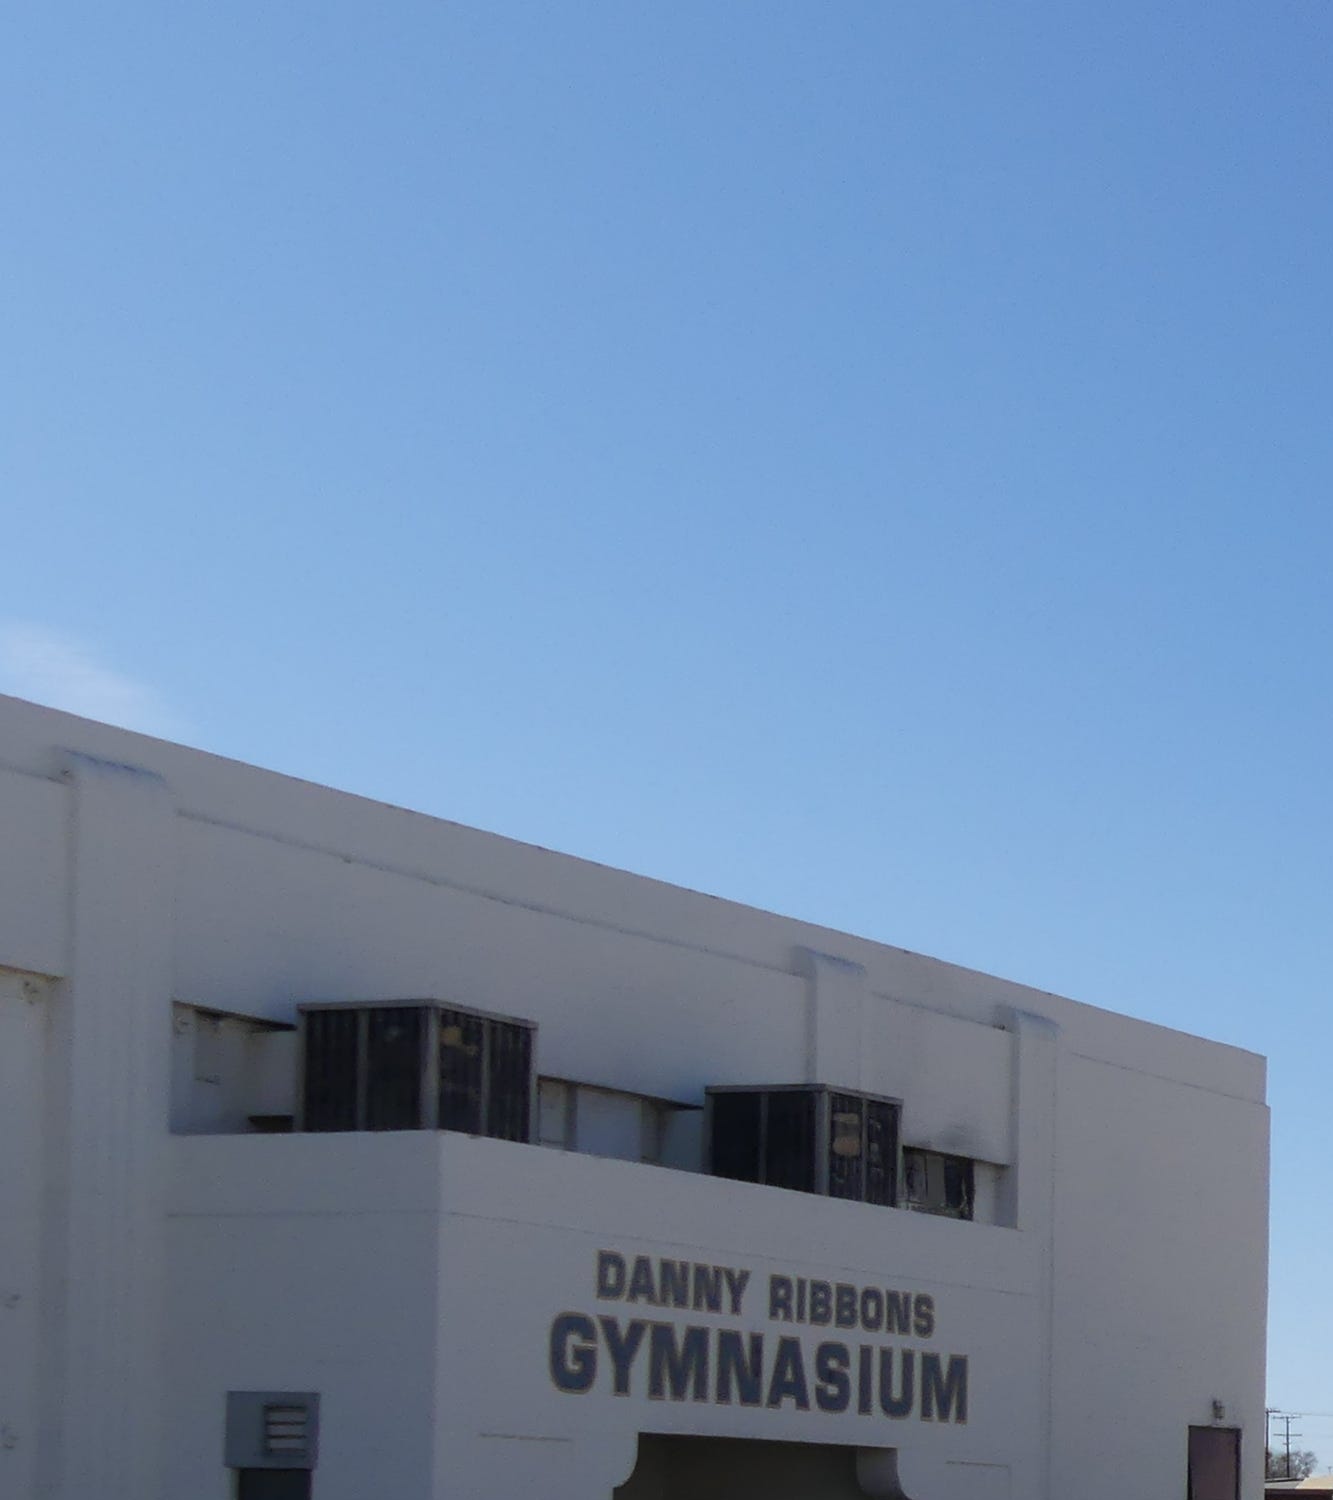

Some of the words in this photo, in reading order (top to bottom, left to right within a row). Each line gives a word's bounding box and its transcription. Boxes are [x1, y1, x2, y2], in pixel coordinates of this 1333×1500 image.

[597, 1249, 751, 1316] DANNY
[768, 1273, 936, 1339] RIBBONS
[549, 1311, 969, 1425] GYMNASIUM
